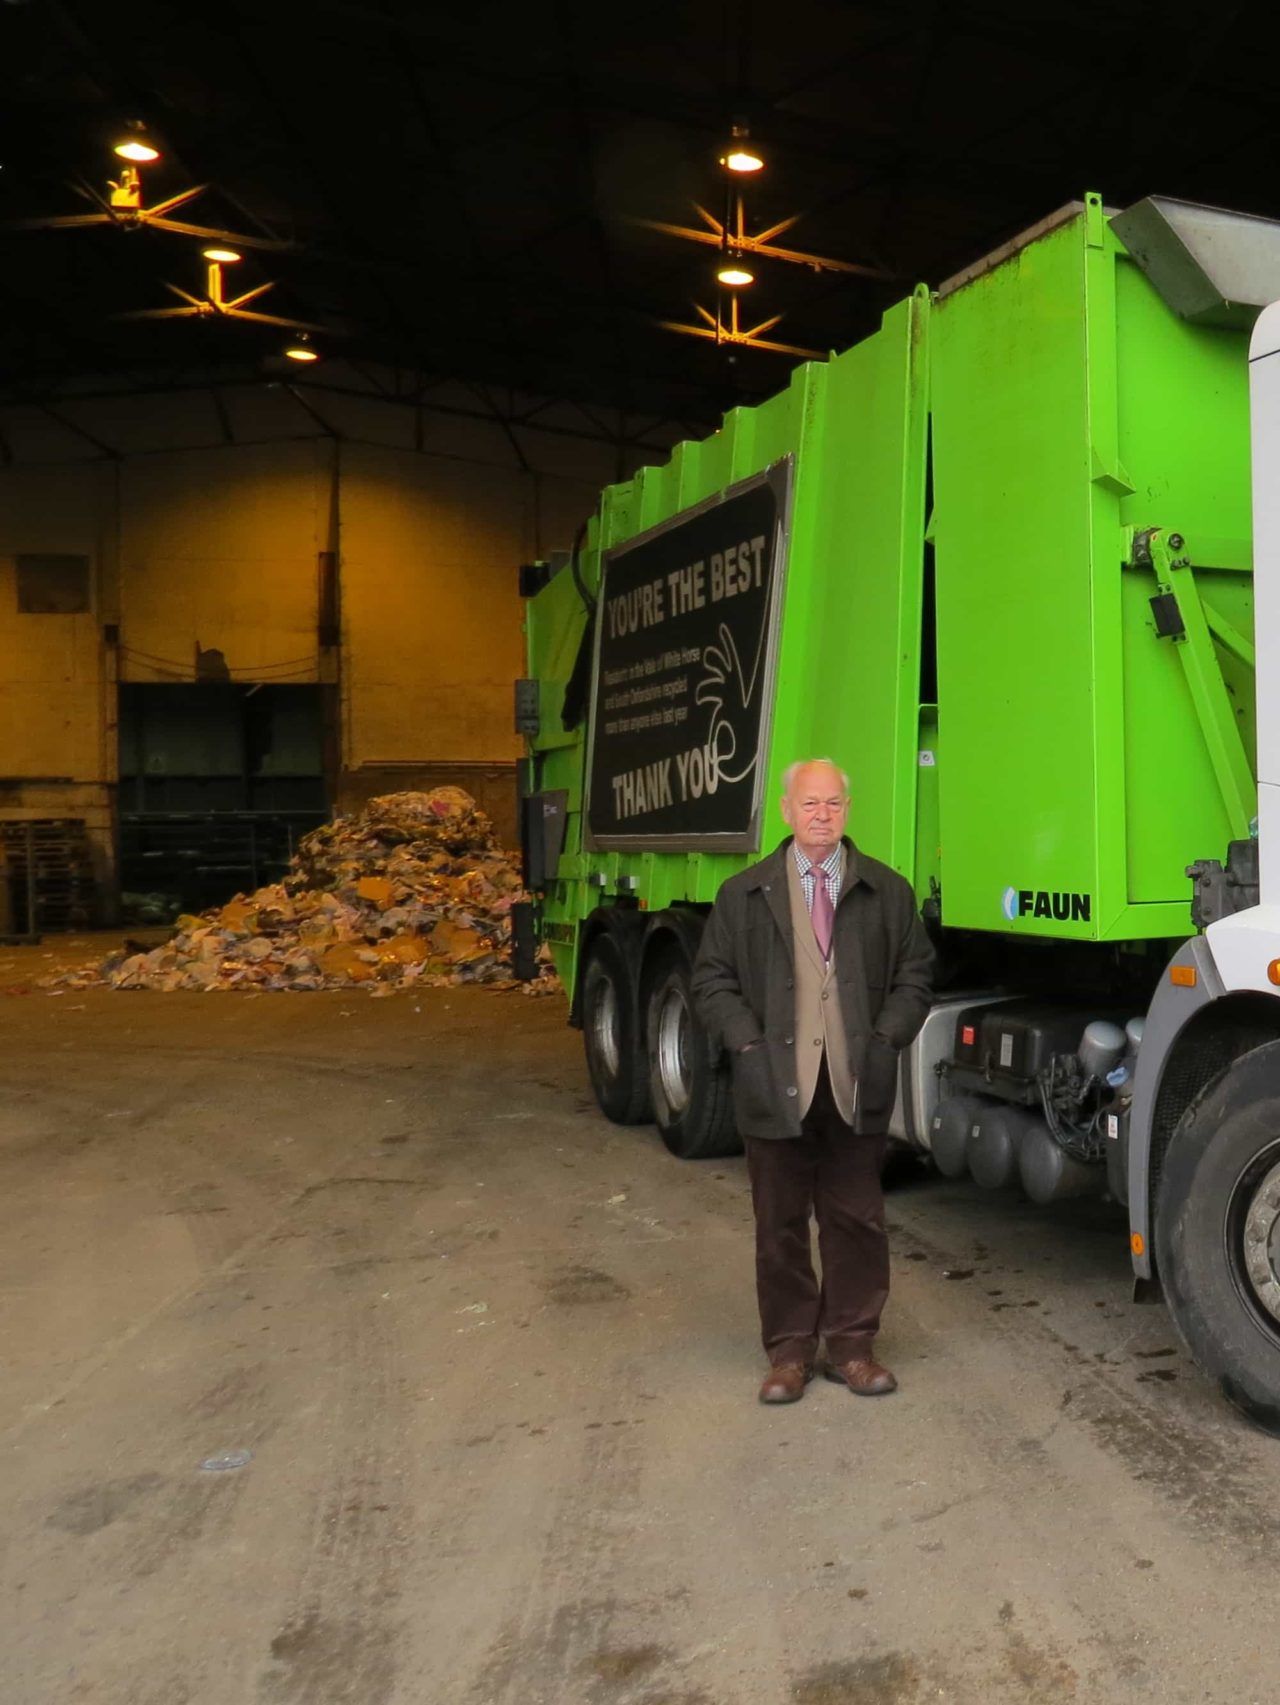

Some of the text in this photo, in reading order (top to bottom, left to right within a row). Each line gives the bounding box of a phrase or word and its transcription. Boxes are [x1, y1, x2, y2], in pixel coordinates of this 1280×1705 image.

[608, 535, 765, 639] YOU'RE THE BEST
[612, 741, 718, 820] THANK YOU
[1018, 891, 1091, 922] FAUN
